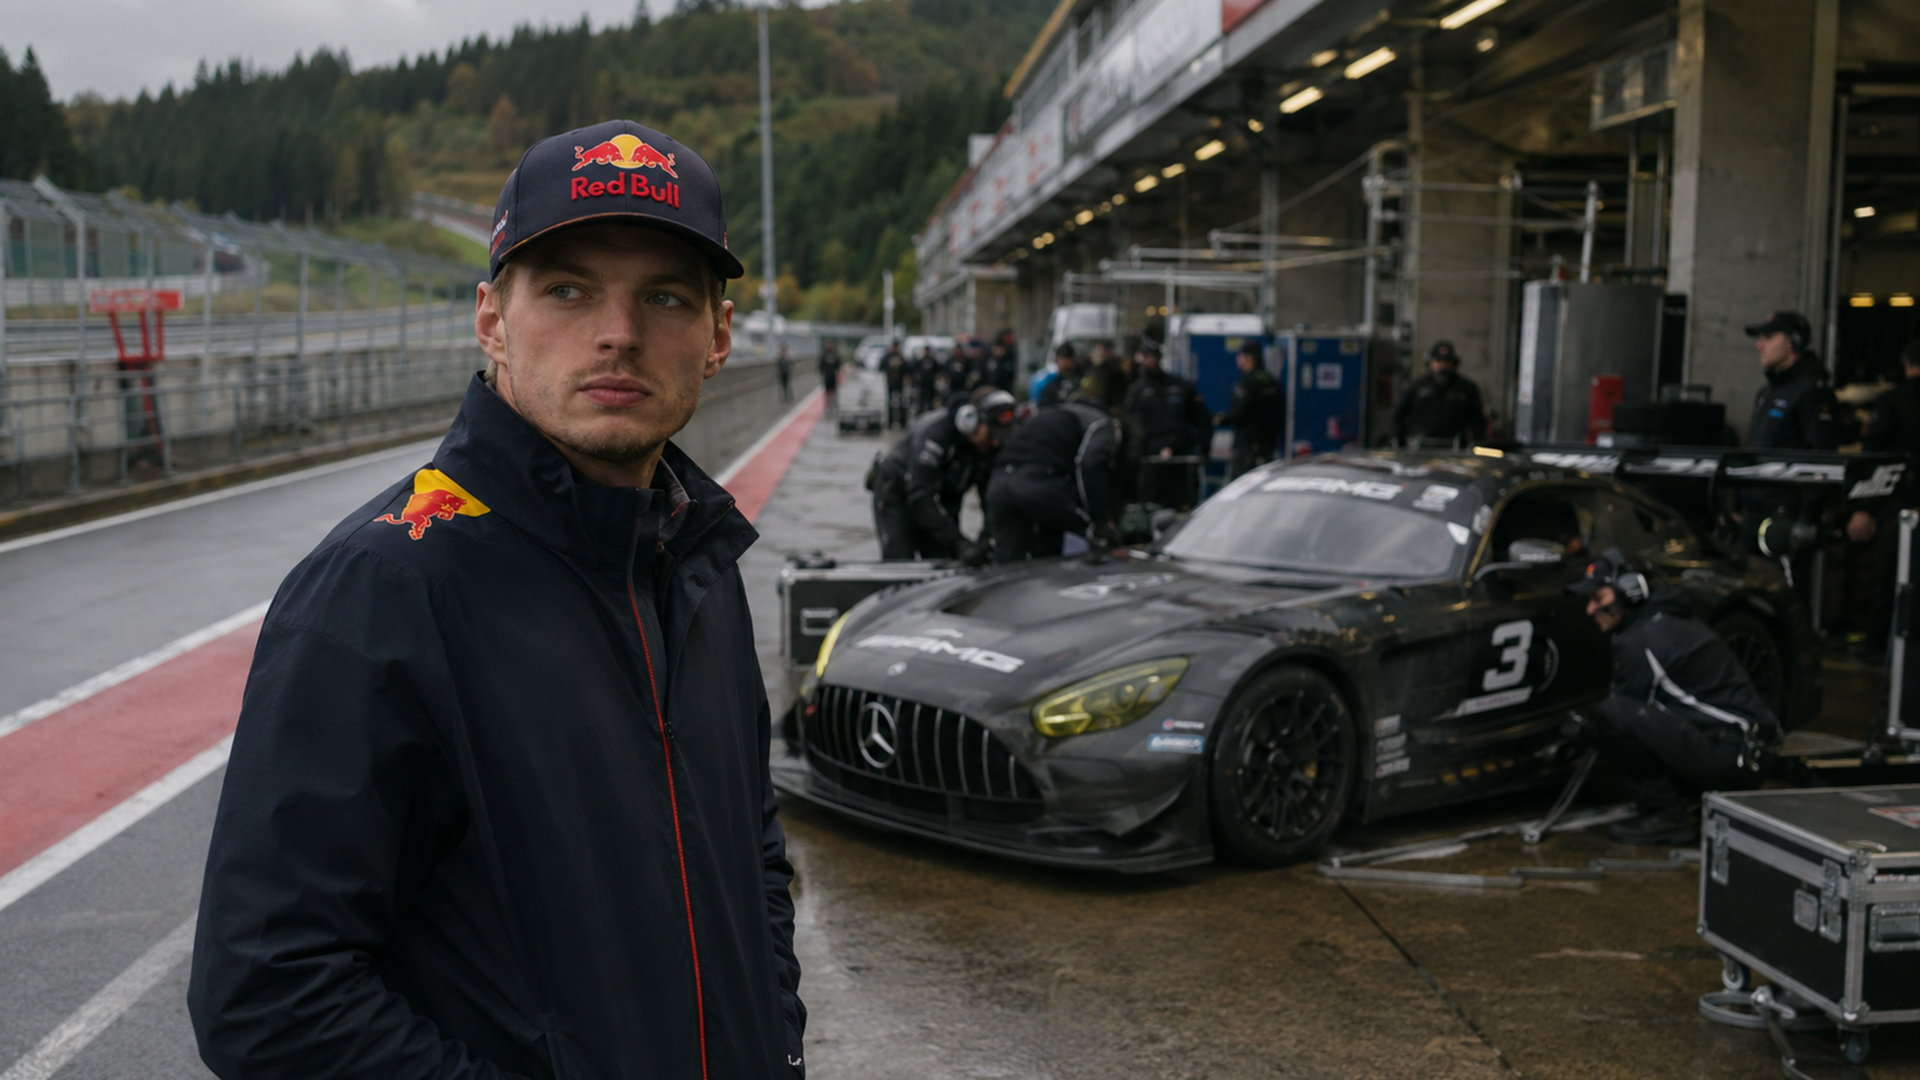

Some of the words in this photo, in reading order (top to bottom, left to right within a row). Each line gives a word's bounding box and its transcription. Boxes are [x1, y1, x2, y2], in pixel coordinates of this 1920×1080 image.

[571, 171, 625, 201] Red
[631, 172, 680, 210] Bull
[1299, 477, 1403, 500] AMG
[889, 636, 1025, 674] AMG
[1482, 619, 1534, 692] 3
